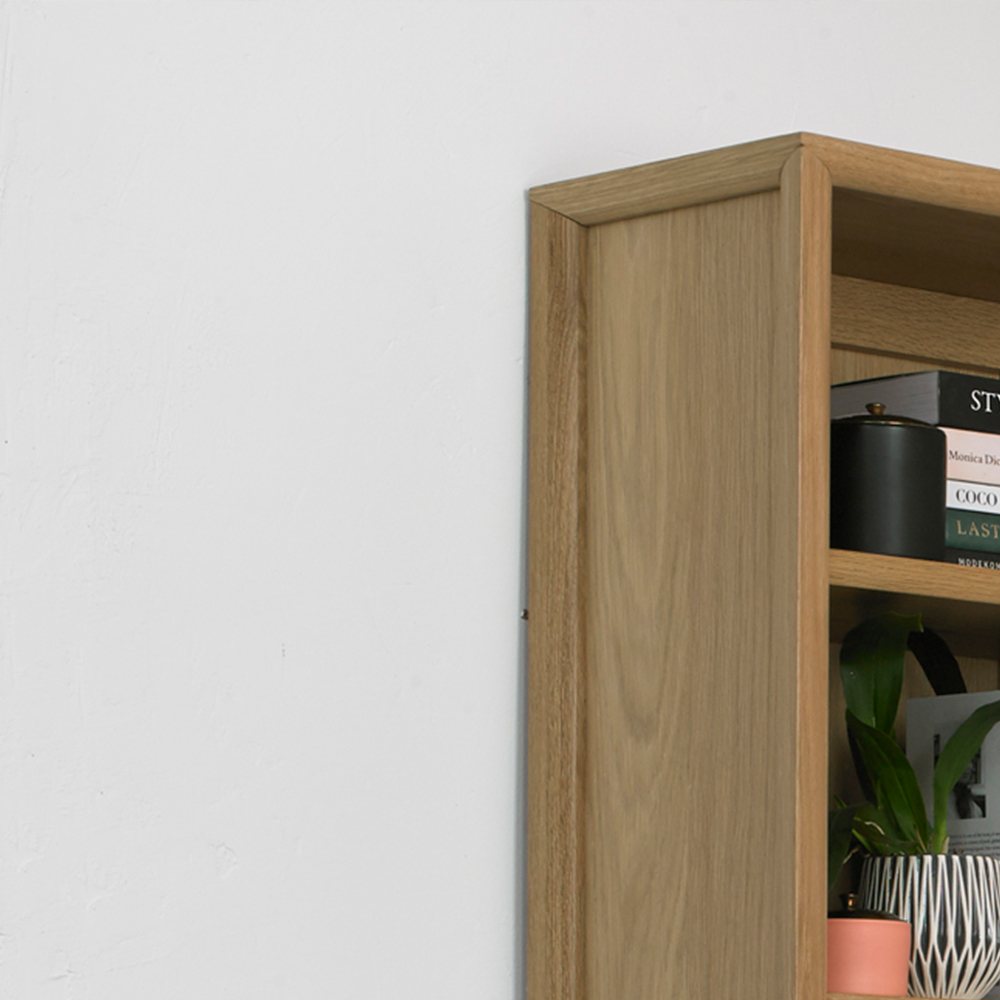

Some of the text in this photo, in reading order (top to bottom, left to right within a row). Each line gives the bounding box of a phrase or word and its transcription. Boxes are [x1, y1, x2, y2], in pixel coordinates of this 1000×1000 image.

[949, 450, 983, 464] Monica
[956, 489, 998, 507] COCO
[956, 520, 1000, 539] LAST
